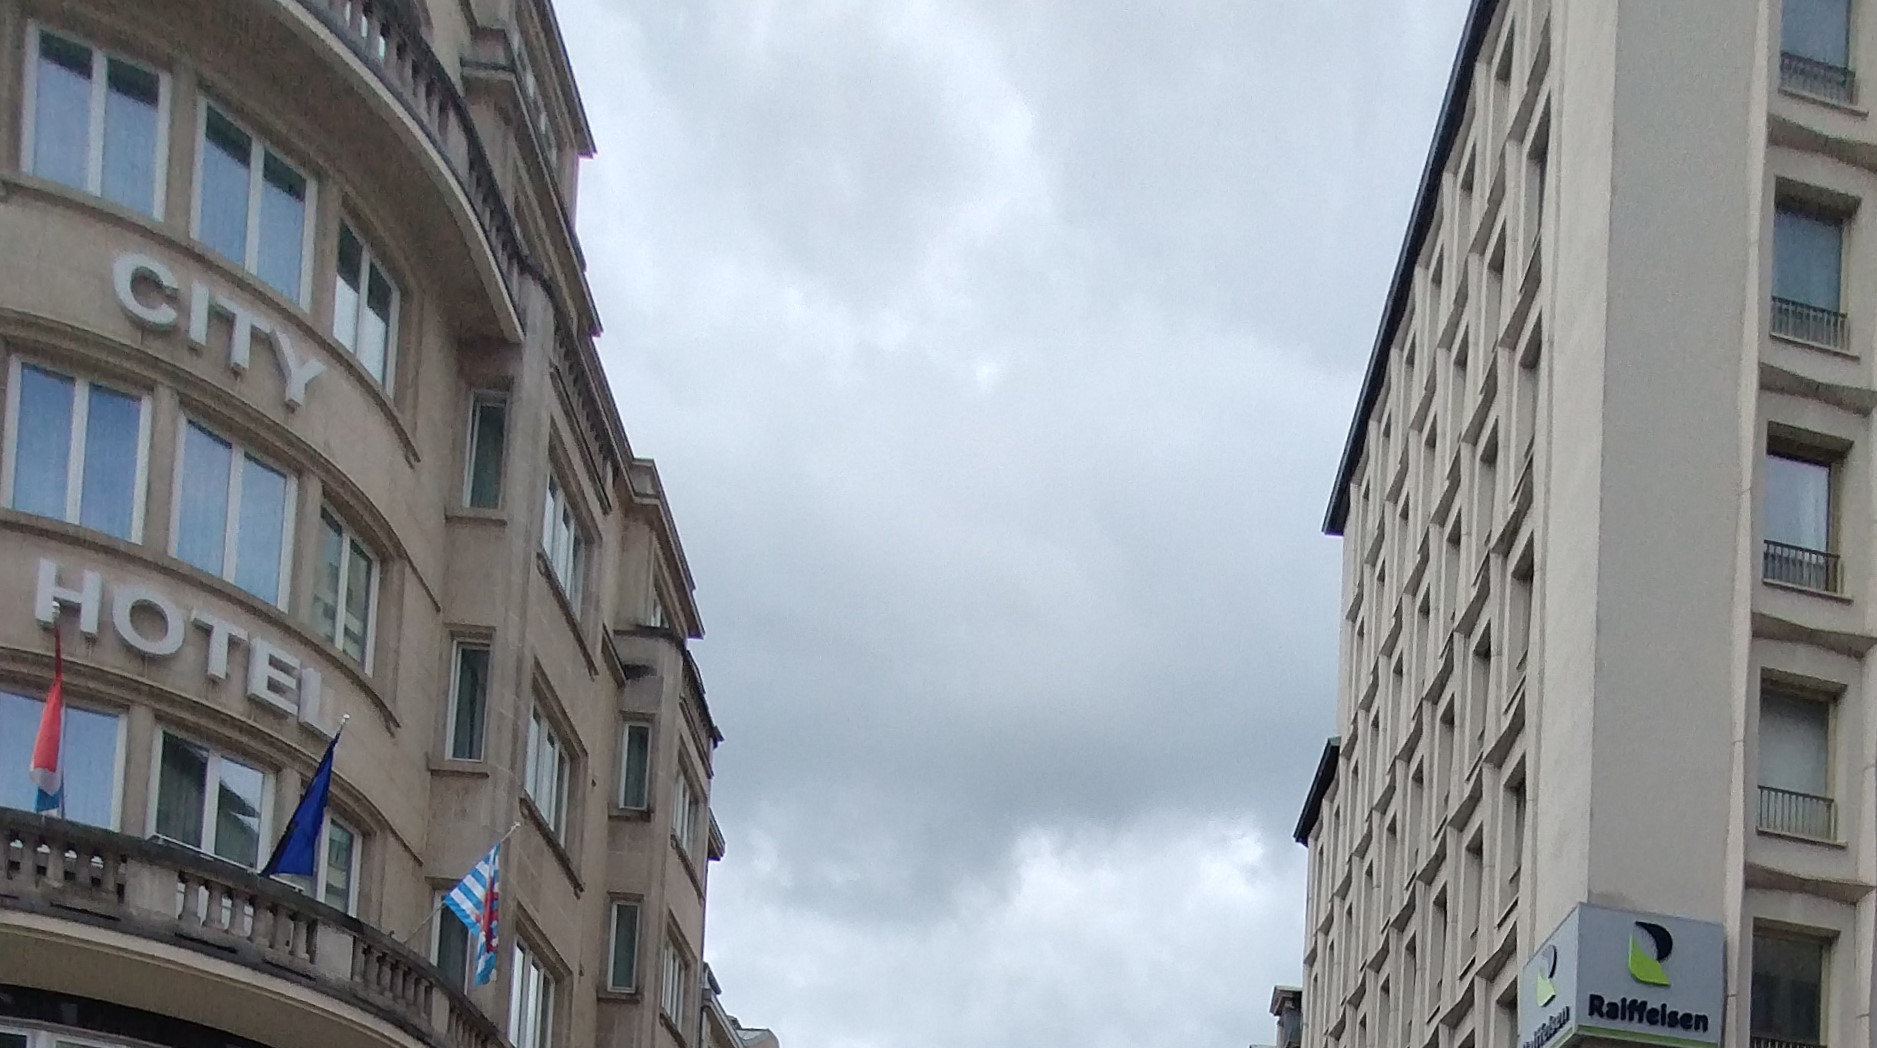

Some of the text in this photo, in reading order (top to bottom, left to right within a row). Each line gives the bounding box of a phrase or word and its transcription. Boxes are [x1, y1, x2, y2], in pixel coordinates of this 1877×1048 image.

[112, 250, 325, 410] CITY
[34, 557, 335, 741] HOTEL
[1588, 993, 1709, 1033] Raiffeisen
